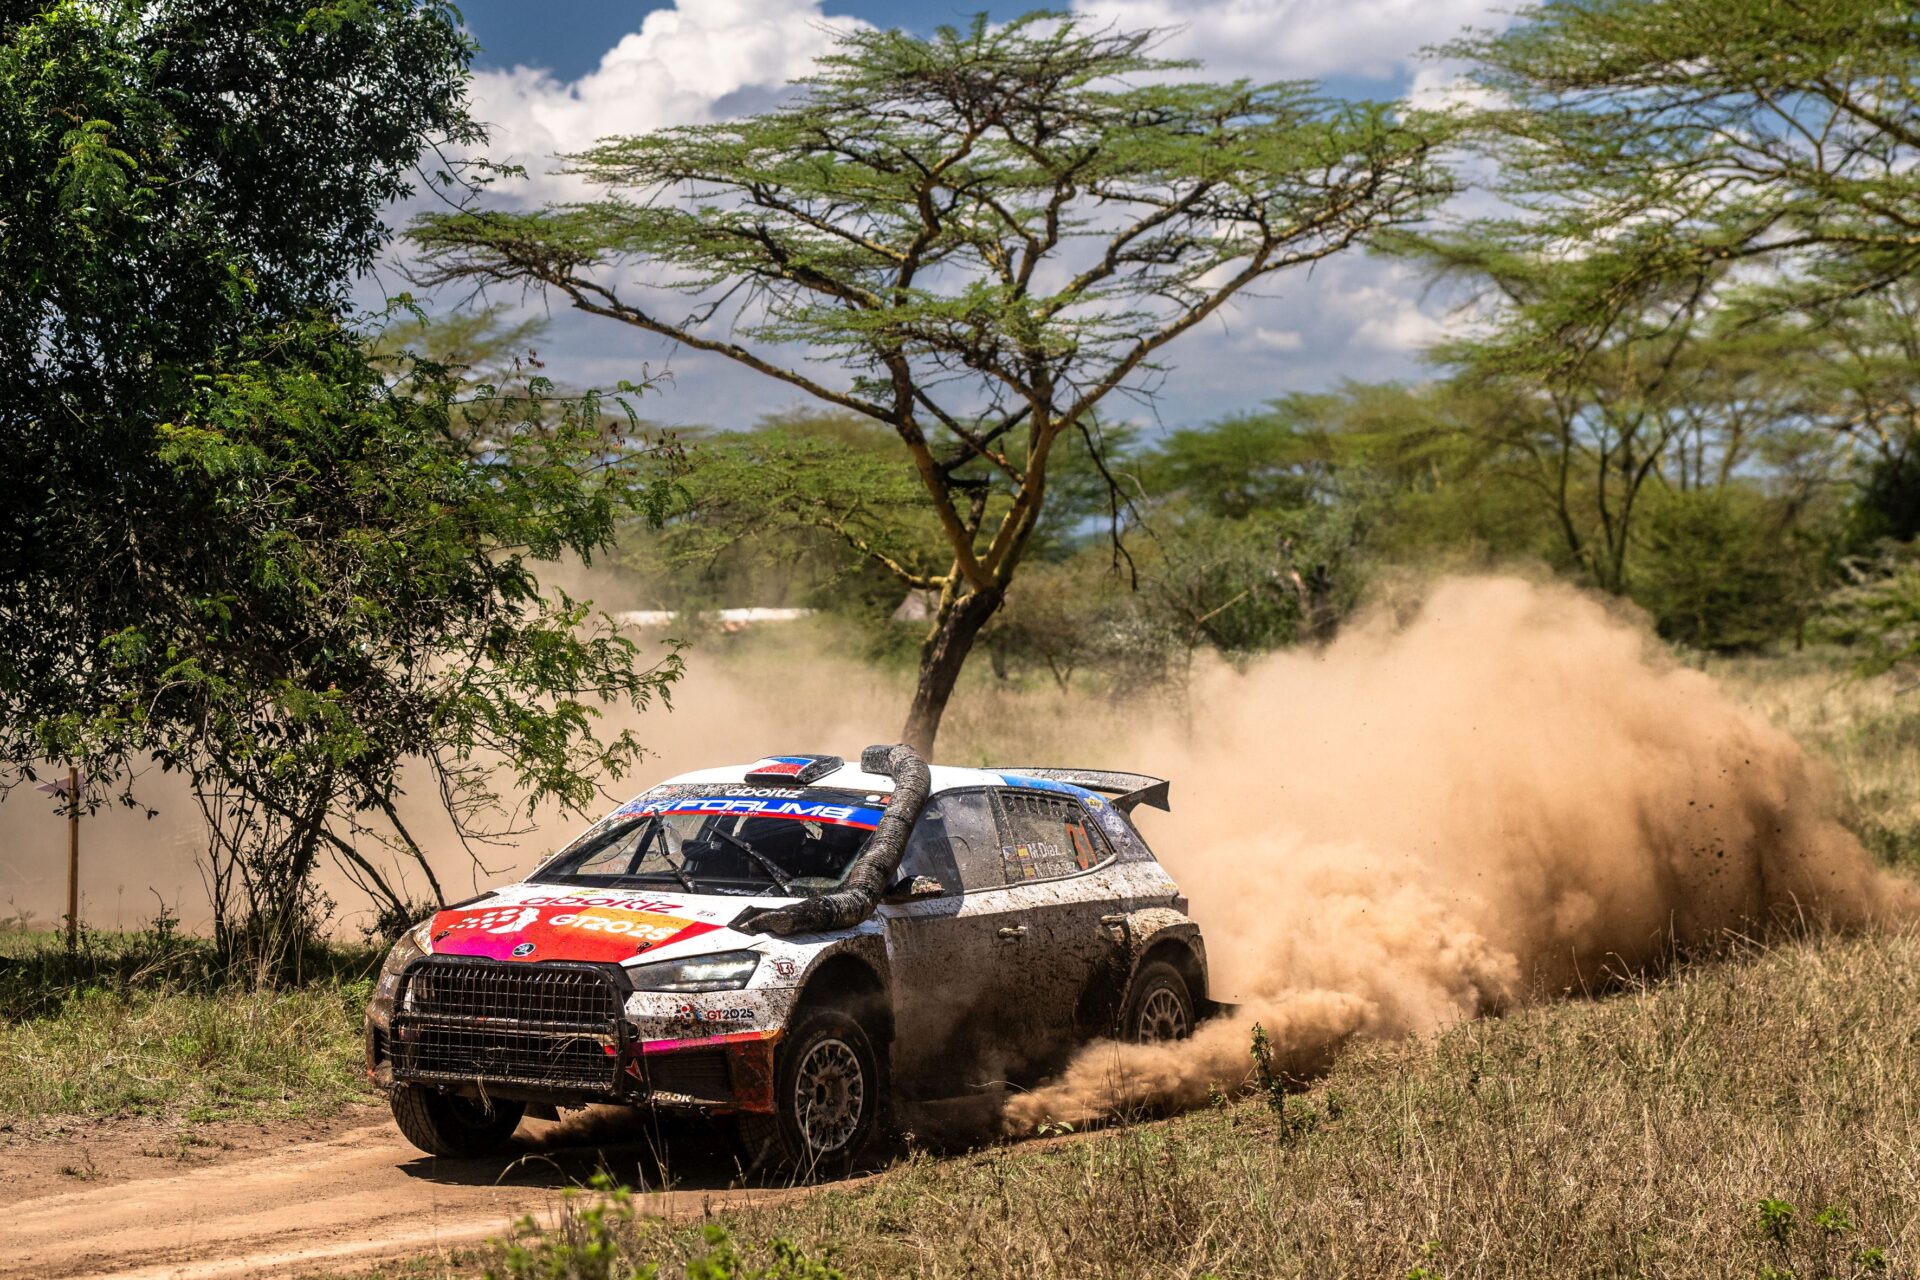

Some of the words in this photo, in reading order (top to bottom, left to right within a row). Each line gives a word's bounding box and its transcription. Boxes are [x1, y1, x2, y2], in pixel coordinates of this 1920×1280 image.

[725, 787, 805, 799] aboitiz
[673, 799, 853, 820] FORUM8
[519, 896, 684, 914] aboitiz
[548, 913, 682, 941] GT2025
[706, 1008, 755, 1021] GT2025
